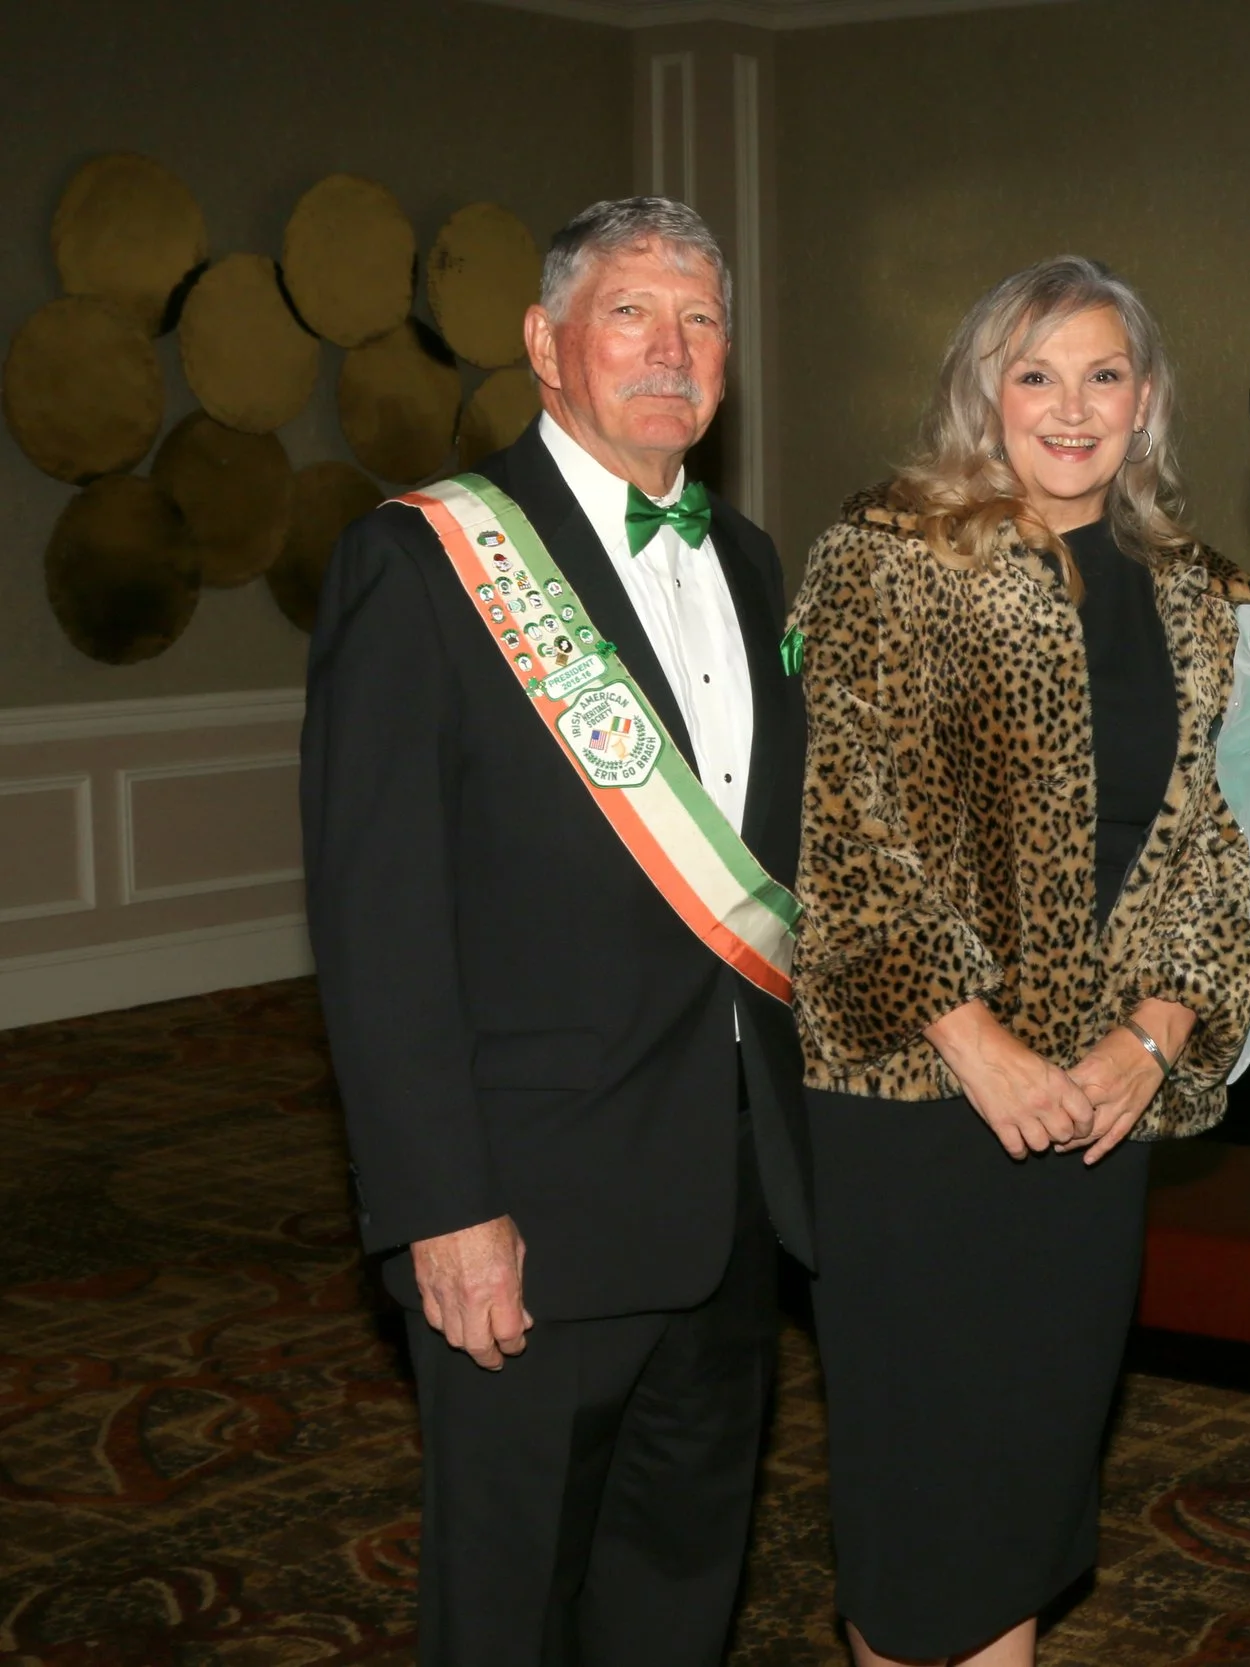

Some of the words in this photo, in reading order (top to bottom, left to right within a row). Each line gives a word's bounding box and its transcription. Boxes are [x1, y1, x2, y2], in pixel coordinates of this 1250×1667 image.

[548, 658, 594, 688] PRESIDENT
[571, 712, 582, 739] IRISH
[581, 692, 629, 710] AMERICAN
[582, 700, 611, 721] HERITAGE
[586, 706, 613, 728] SOCIETY
[594, 769, 618, 781] ERIN
[623, 768, 636, 779] GO
[638, 737, 656, 769] BRAGH
